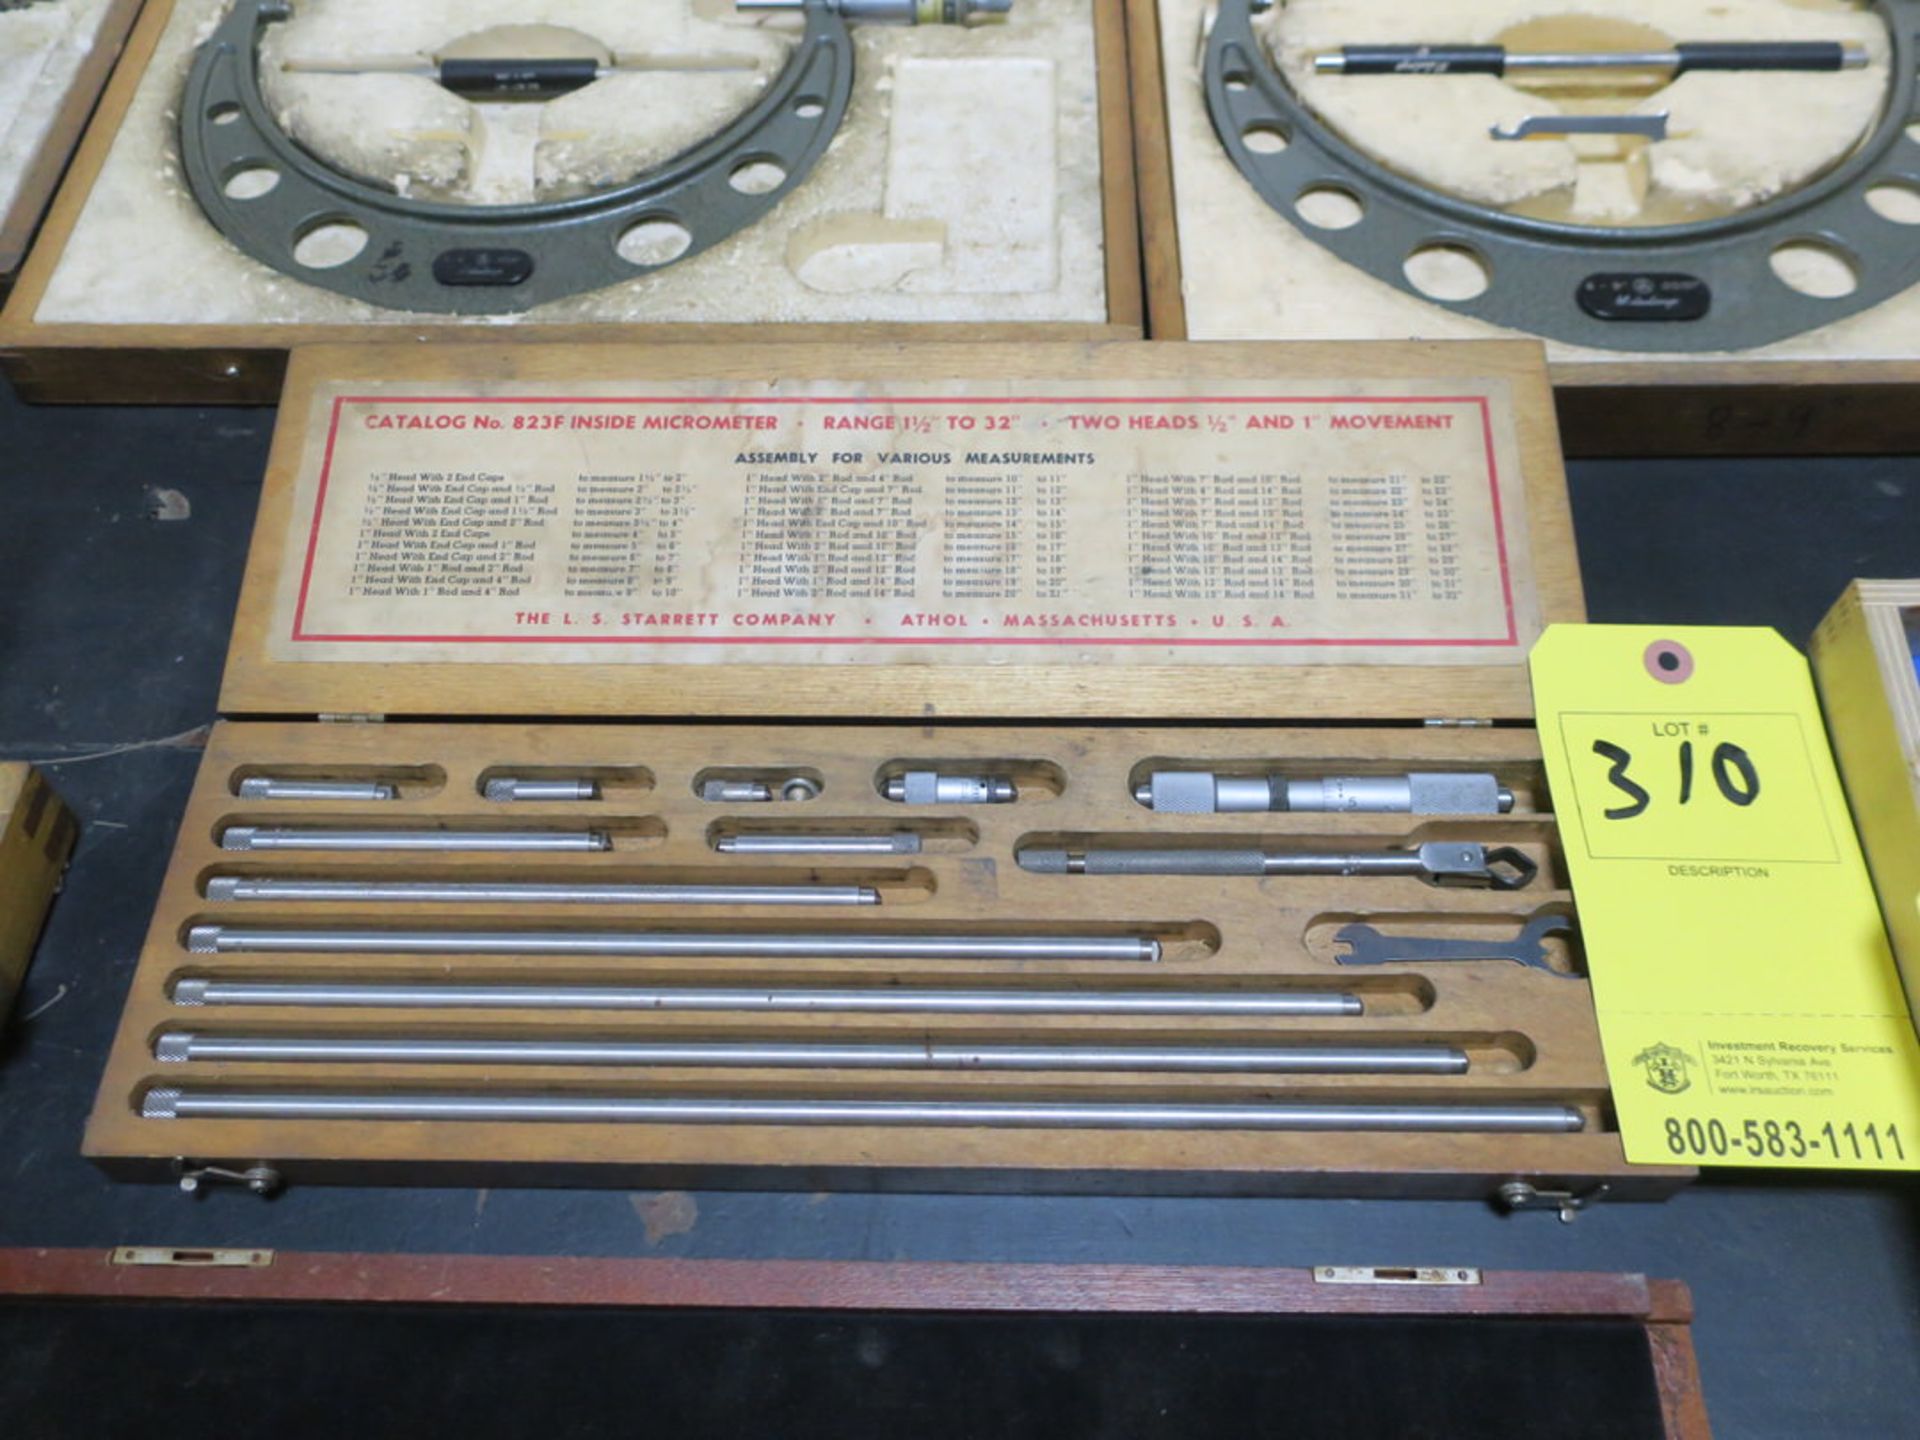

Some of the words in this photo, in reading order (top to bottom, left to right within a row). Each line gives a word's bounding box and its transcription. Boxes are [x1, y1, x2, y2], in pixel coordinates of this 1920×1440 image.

[365, 413, 467, 430] CATALOG
[473, 414, 503, 430] No.
[512, 414, 565, 430] 823F
[570, 414, 636, 430] INSIDE
[642, 414, 779, 431] MICROMETER
[822, 414, 896, 431] RANGE
[946, 415, 977, 431] TO
[985, 415, 1020, 431] 32"
[1068, 414, 1122, 431] TWO
[1127, 414, 1199, 431] HEADS
[1246, 414, 1296, 431] AND
[1303, 415, 1321, 430] 1"
[1329, 414, 1454, 431] MOVEMENT
[735, 452, 817, 464] ASSEMBLY
[832, 452, 863, 464] FOR
[878, 452, 951, 464] VARIOUS
[965, 452, 1095, 465] MEASUREMENTS
[515, 611, 550, 625] THE
[622, 612, 719, 626] STARRETT
[732, 613, 835, 626] COMPANY
[901, 613, 968, 627] ATHOL
[1003, 613, 1178, 628] MASSACHUSETTS
[1652, 722, 1690, 737] LOT
[1697, 723, 1710, 736] #
[1592, 740, 1760, 820] 310
[1667, 864, 1770, 878] DESCRIPTION
[1707, 1040, 1776, 1052] Investment
[1779, 1041, 1836, 1055] Recovery
[1840, 1043, 1894, 1055] Services
[1715, 1070, 1738, 1081] Fort
[1783, 1071, 1801, 1081] TX
[1664, 1117, 1905, 1161] 800-583-1111
